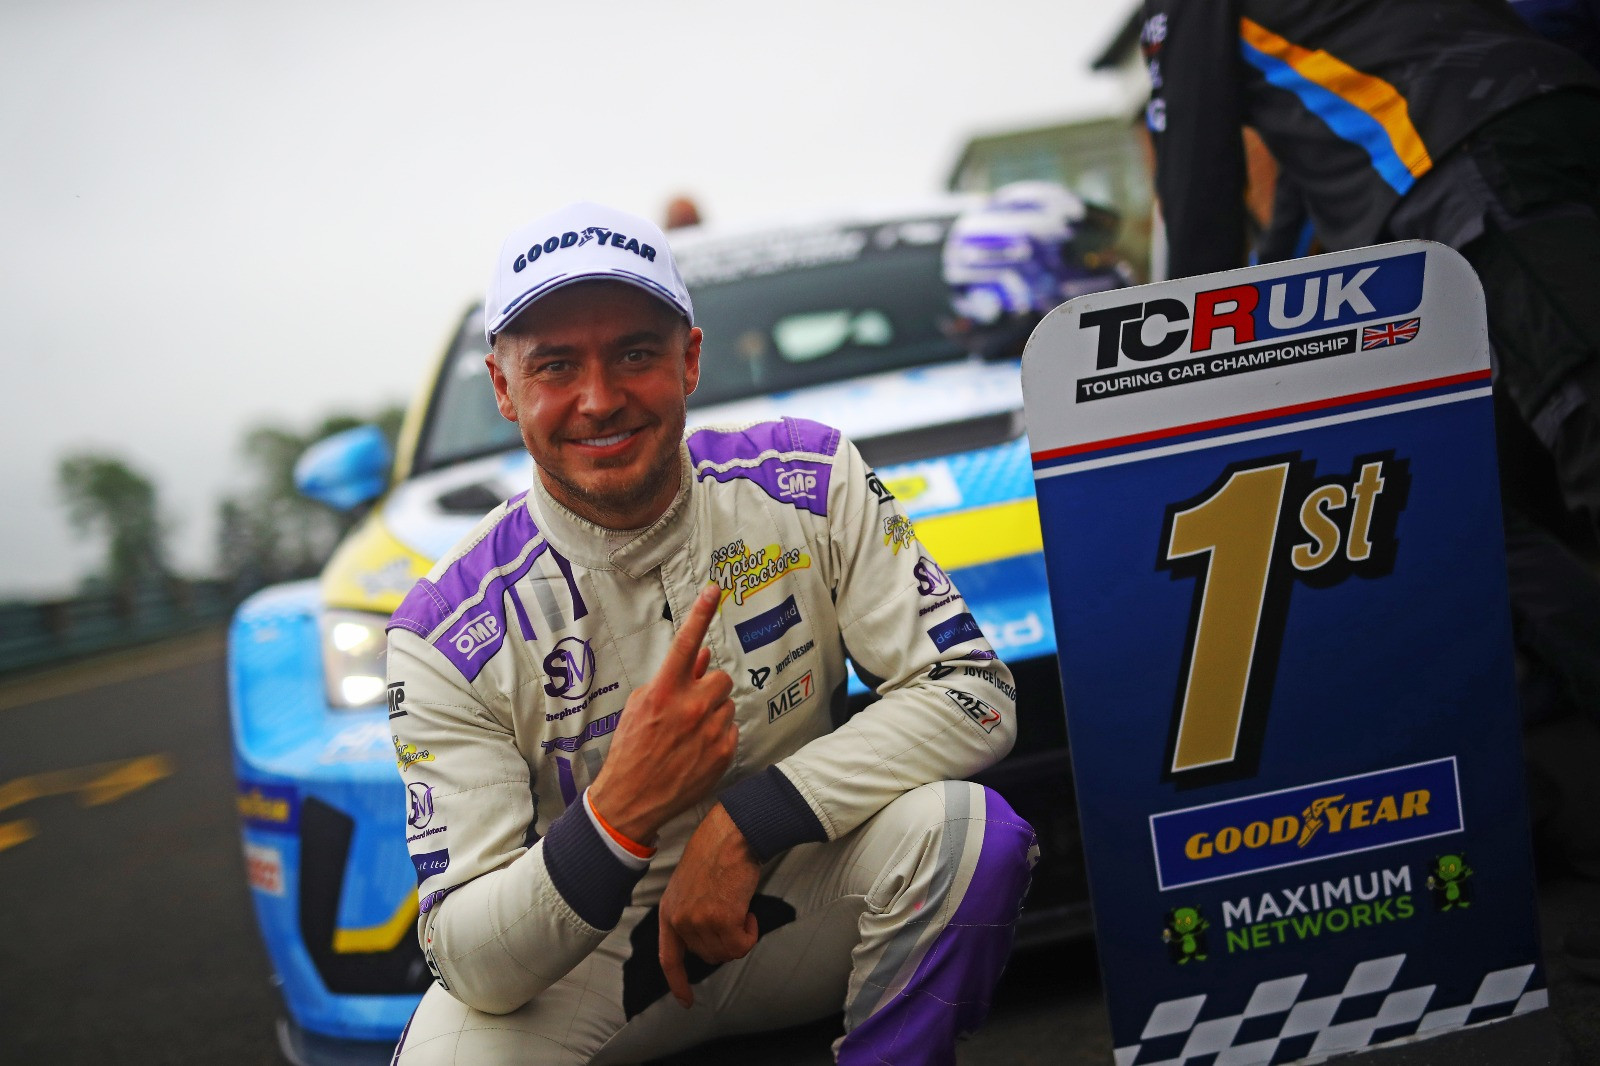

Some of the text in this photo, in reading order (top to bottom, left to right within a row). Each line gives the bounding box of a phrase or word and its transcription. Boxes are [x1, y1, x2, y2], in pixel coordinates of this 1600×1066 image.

[1079, 266, 1381, 370] TCR UK
[1082, 336, 1349, 397] TOURING CAR CHAMPIONSHIP
[715, 549, 765, 590] Motor
[734, 548, 799, 606] Factors
[918, 596, 951, 617] Shepherd
[1166, 461, 1385, 773] 1st
[456, 616, 498, 653] OMP
[387, 687, 405, 712] MP
[545, 699, 588, 721] hepherd
[769, 674, 811, 719] ME7
[430, 858, 448, 869] ltd
[1221, 865, 1413, 928] MAXIMUM
[1226, 895, 1415, 953] NETWORKS
